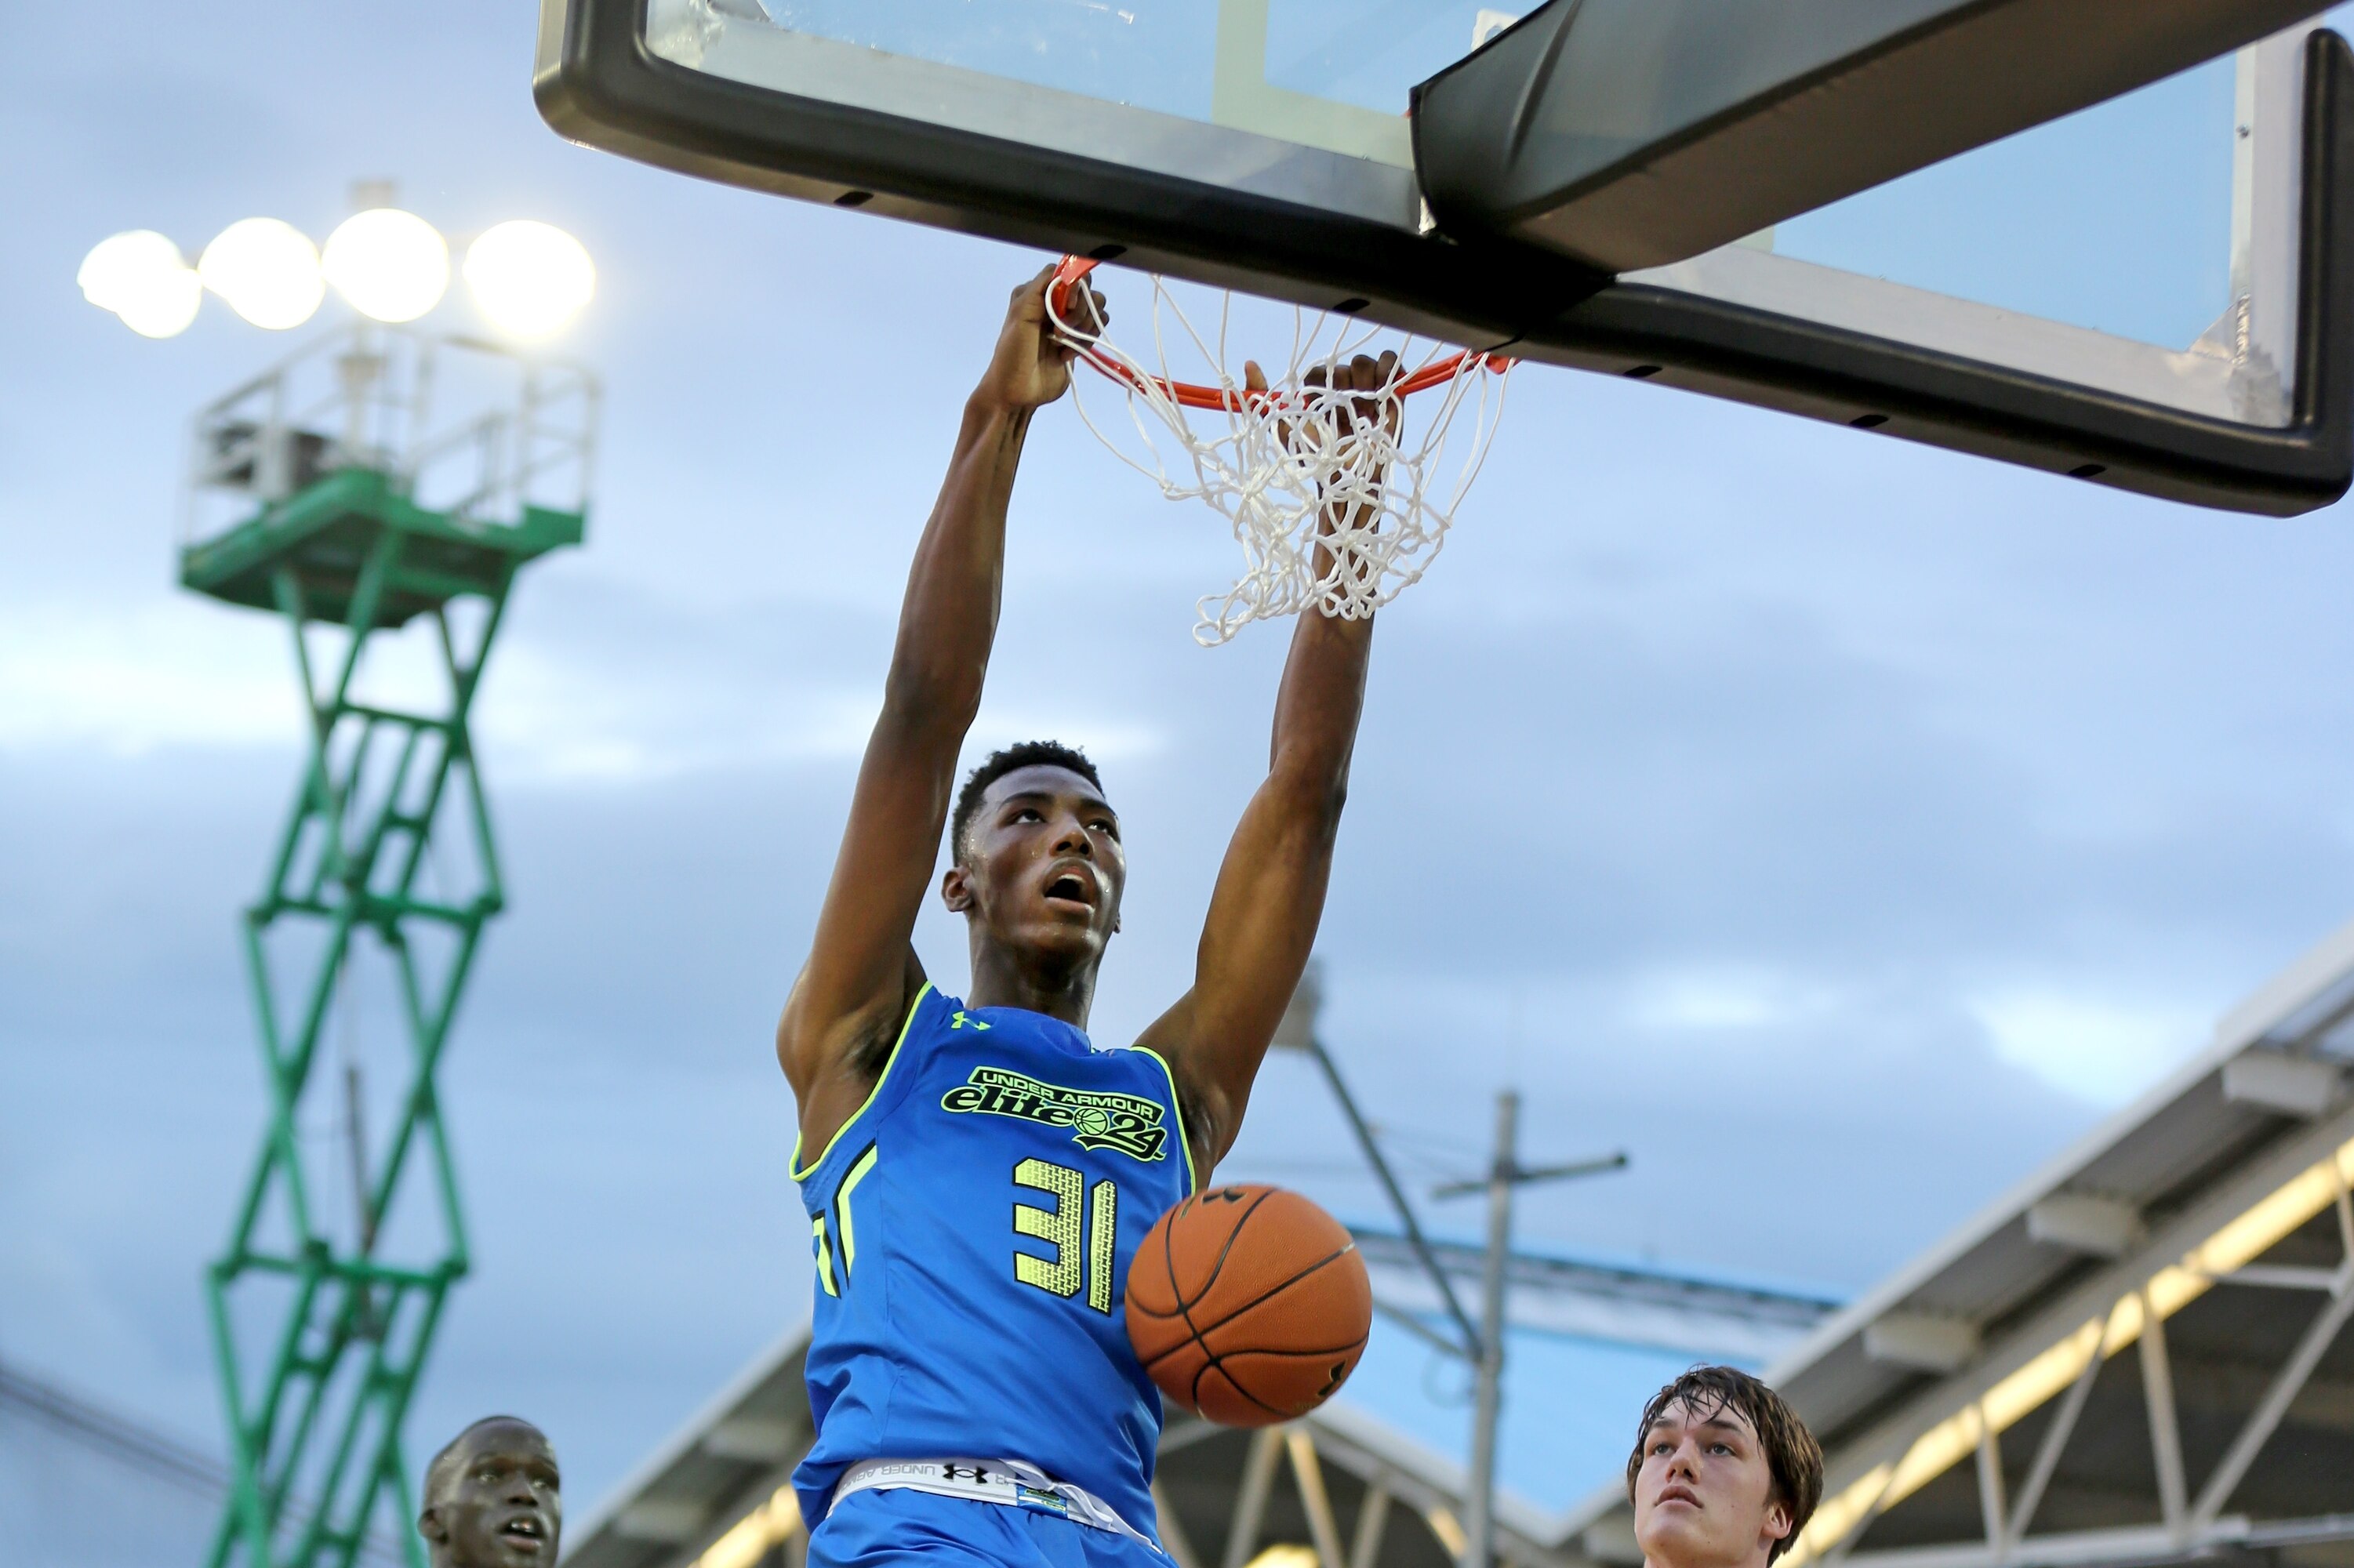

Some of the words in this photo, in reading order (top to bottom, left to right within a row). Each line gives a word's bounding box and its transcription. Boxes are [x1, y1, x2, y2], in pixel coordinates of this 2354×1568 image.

[982, 1071, 1055, 1100] UNDER
[1061, 1092, 1154, 1120] ARMOUR
[1104, 1111, 1168, 1162] 24
[1013, 1157, 1117, 1317] 31
[881, 1464, 935, 1475] UNDER
